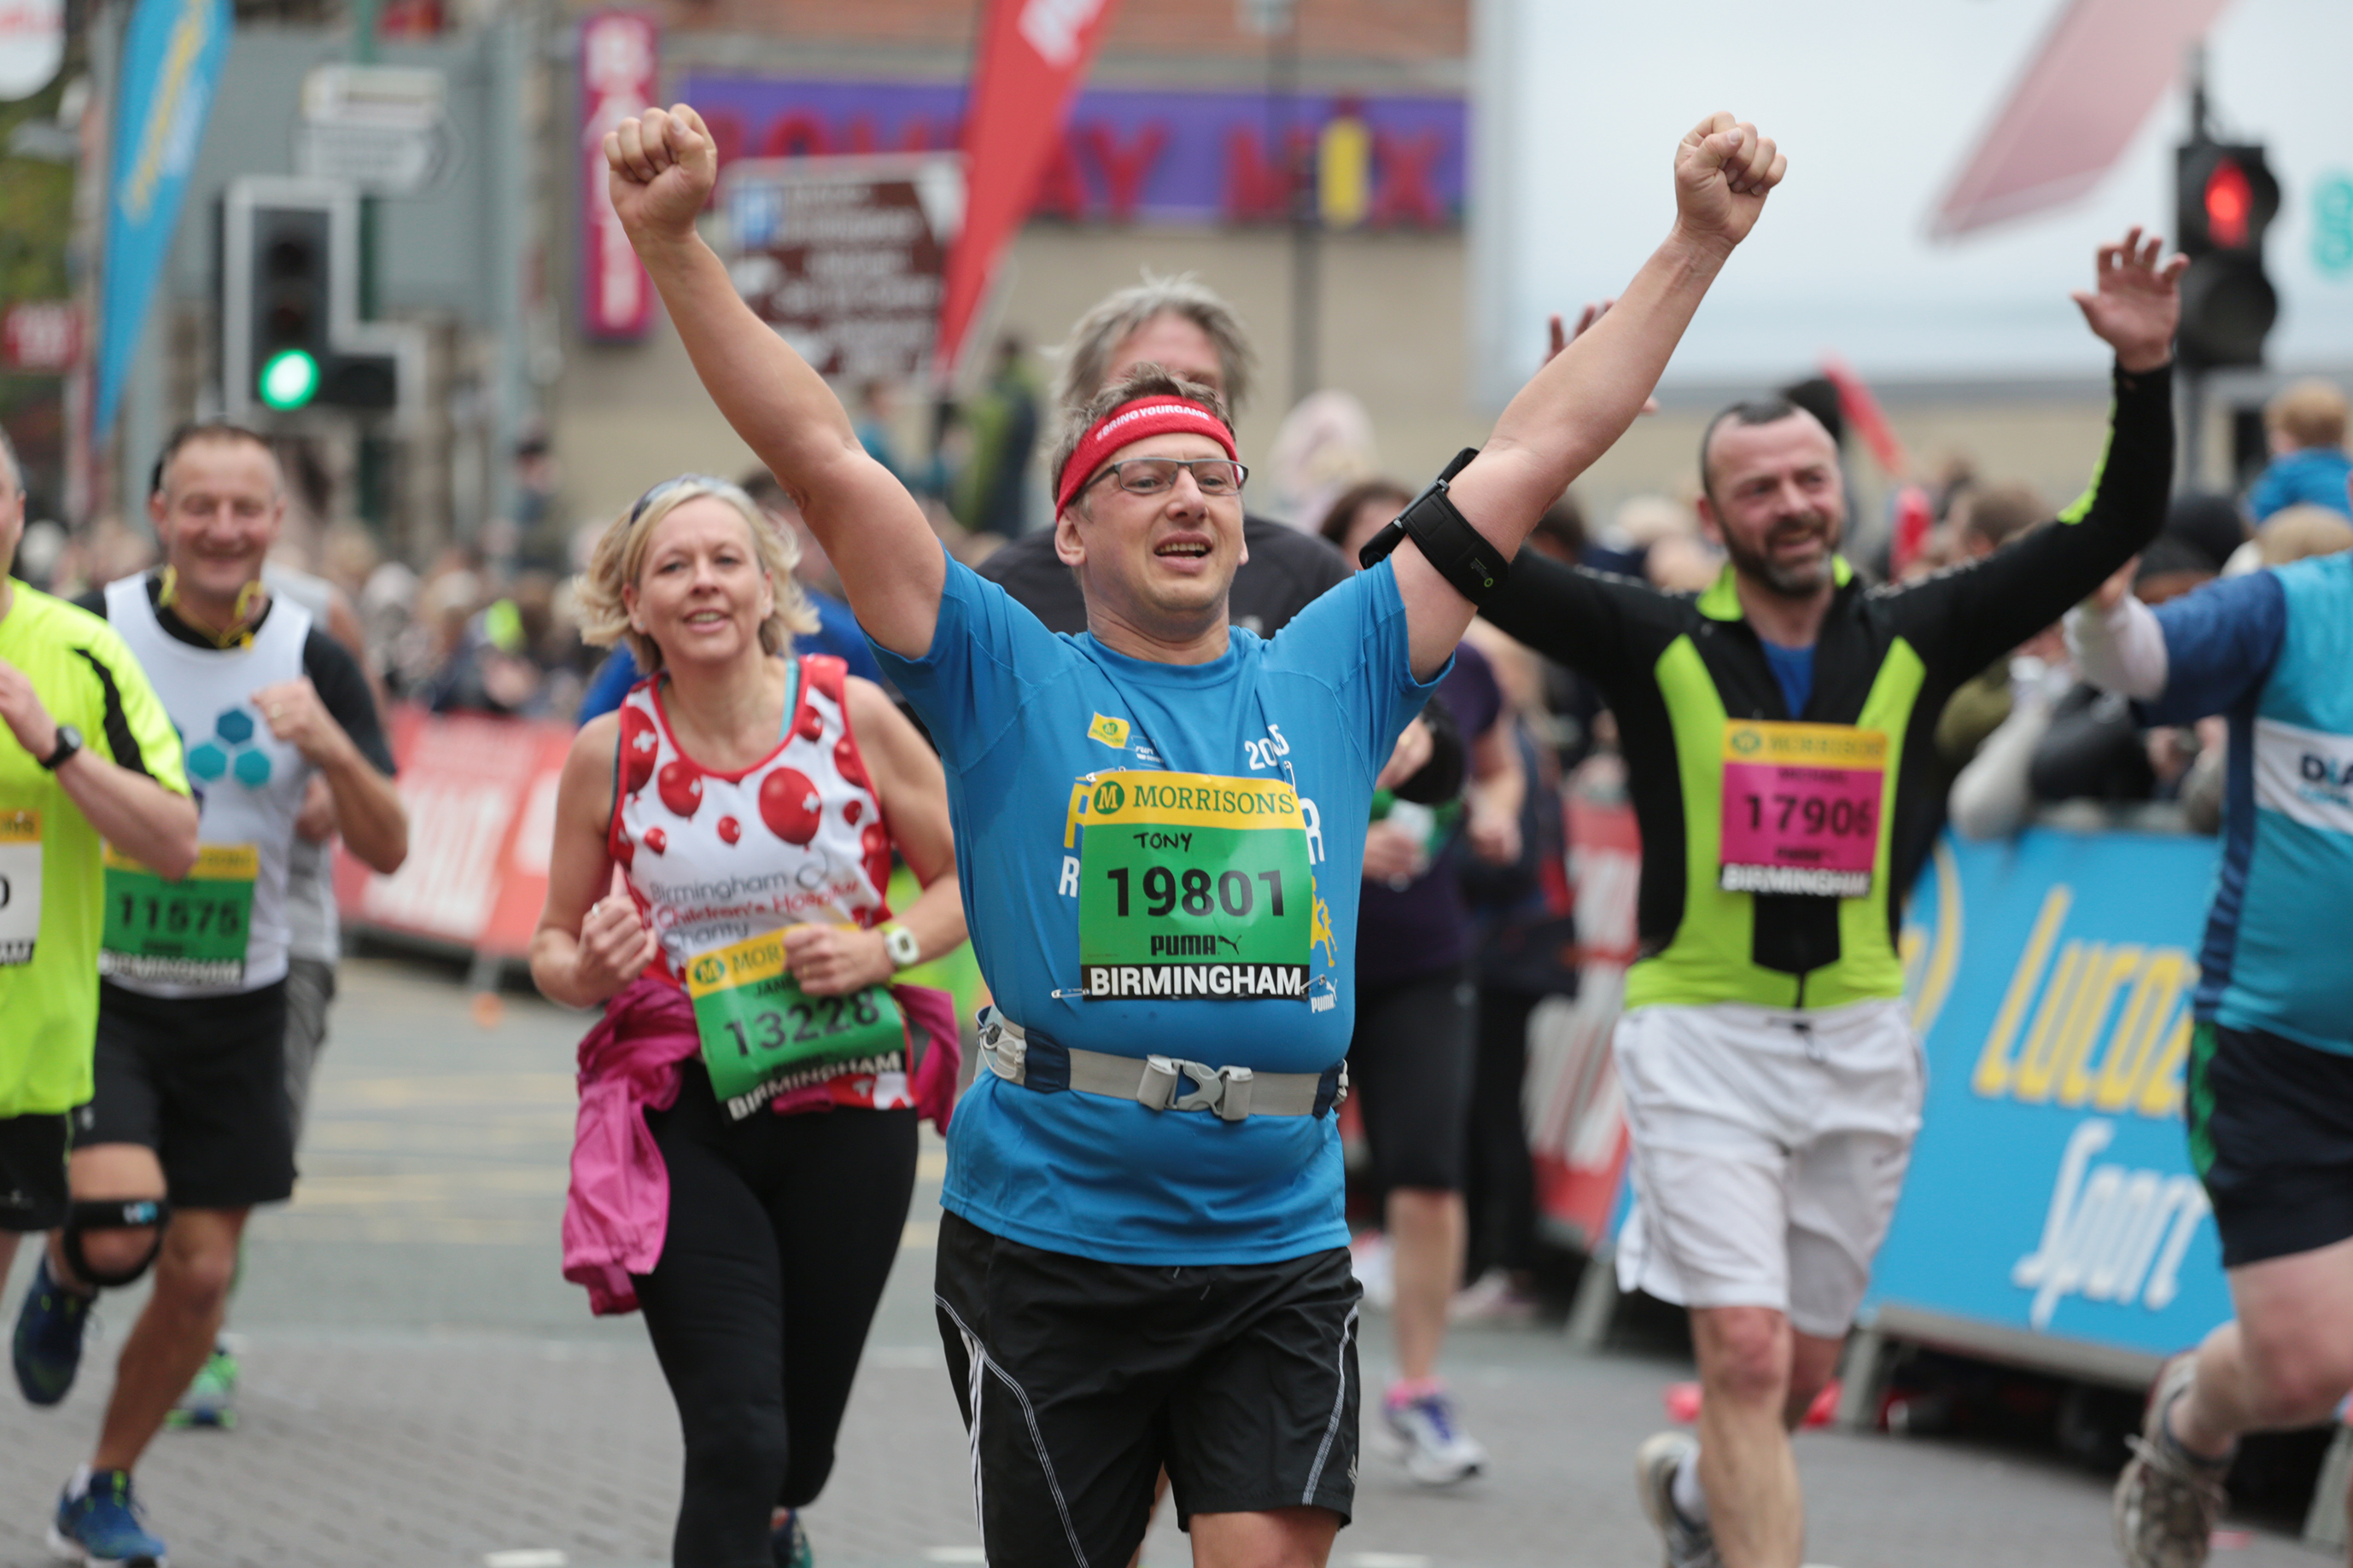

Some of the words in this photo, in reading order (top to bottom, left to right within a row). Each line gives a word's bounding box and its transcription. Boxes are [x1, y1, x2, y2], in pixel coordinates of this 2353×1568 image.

[1244, 724, 1290, 771] 205
[1095, 783, 1122, 812] M
[1133, 784, 1295, 814] MORRISONS
[1744, 795, 1874, 838] 17906
[1133, 832, 1193, 853] TONY
[650, 872, 787, 902] Birmingham
[1107, 866, 1284, 918] 19801
[657, 900, 766, 930] Children's
[733, 942, 781, 973] MOR
[1151, 935, 1217, 956] PUMA
[755, 979, 786, 999] JAN
[1090, 965, 1302, 997] BIRMINGHAM
[1311, 998, 1335, 1013] PUMA
[1972, 884, 2201, 1118] Lucoz
[724, 990, 880, 1058] 13228
